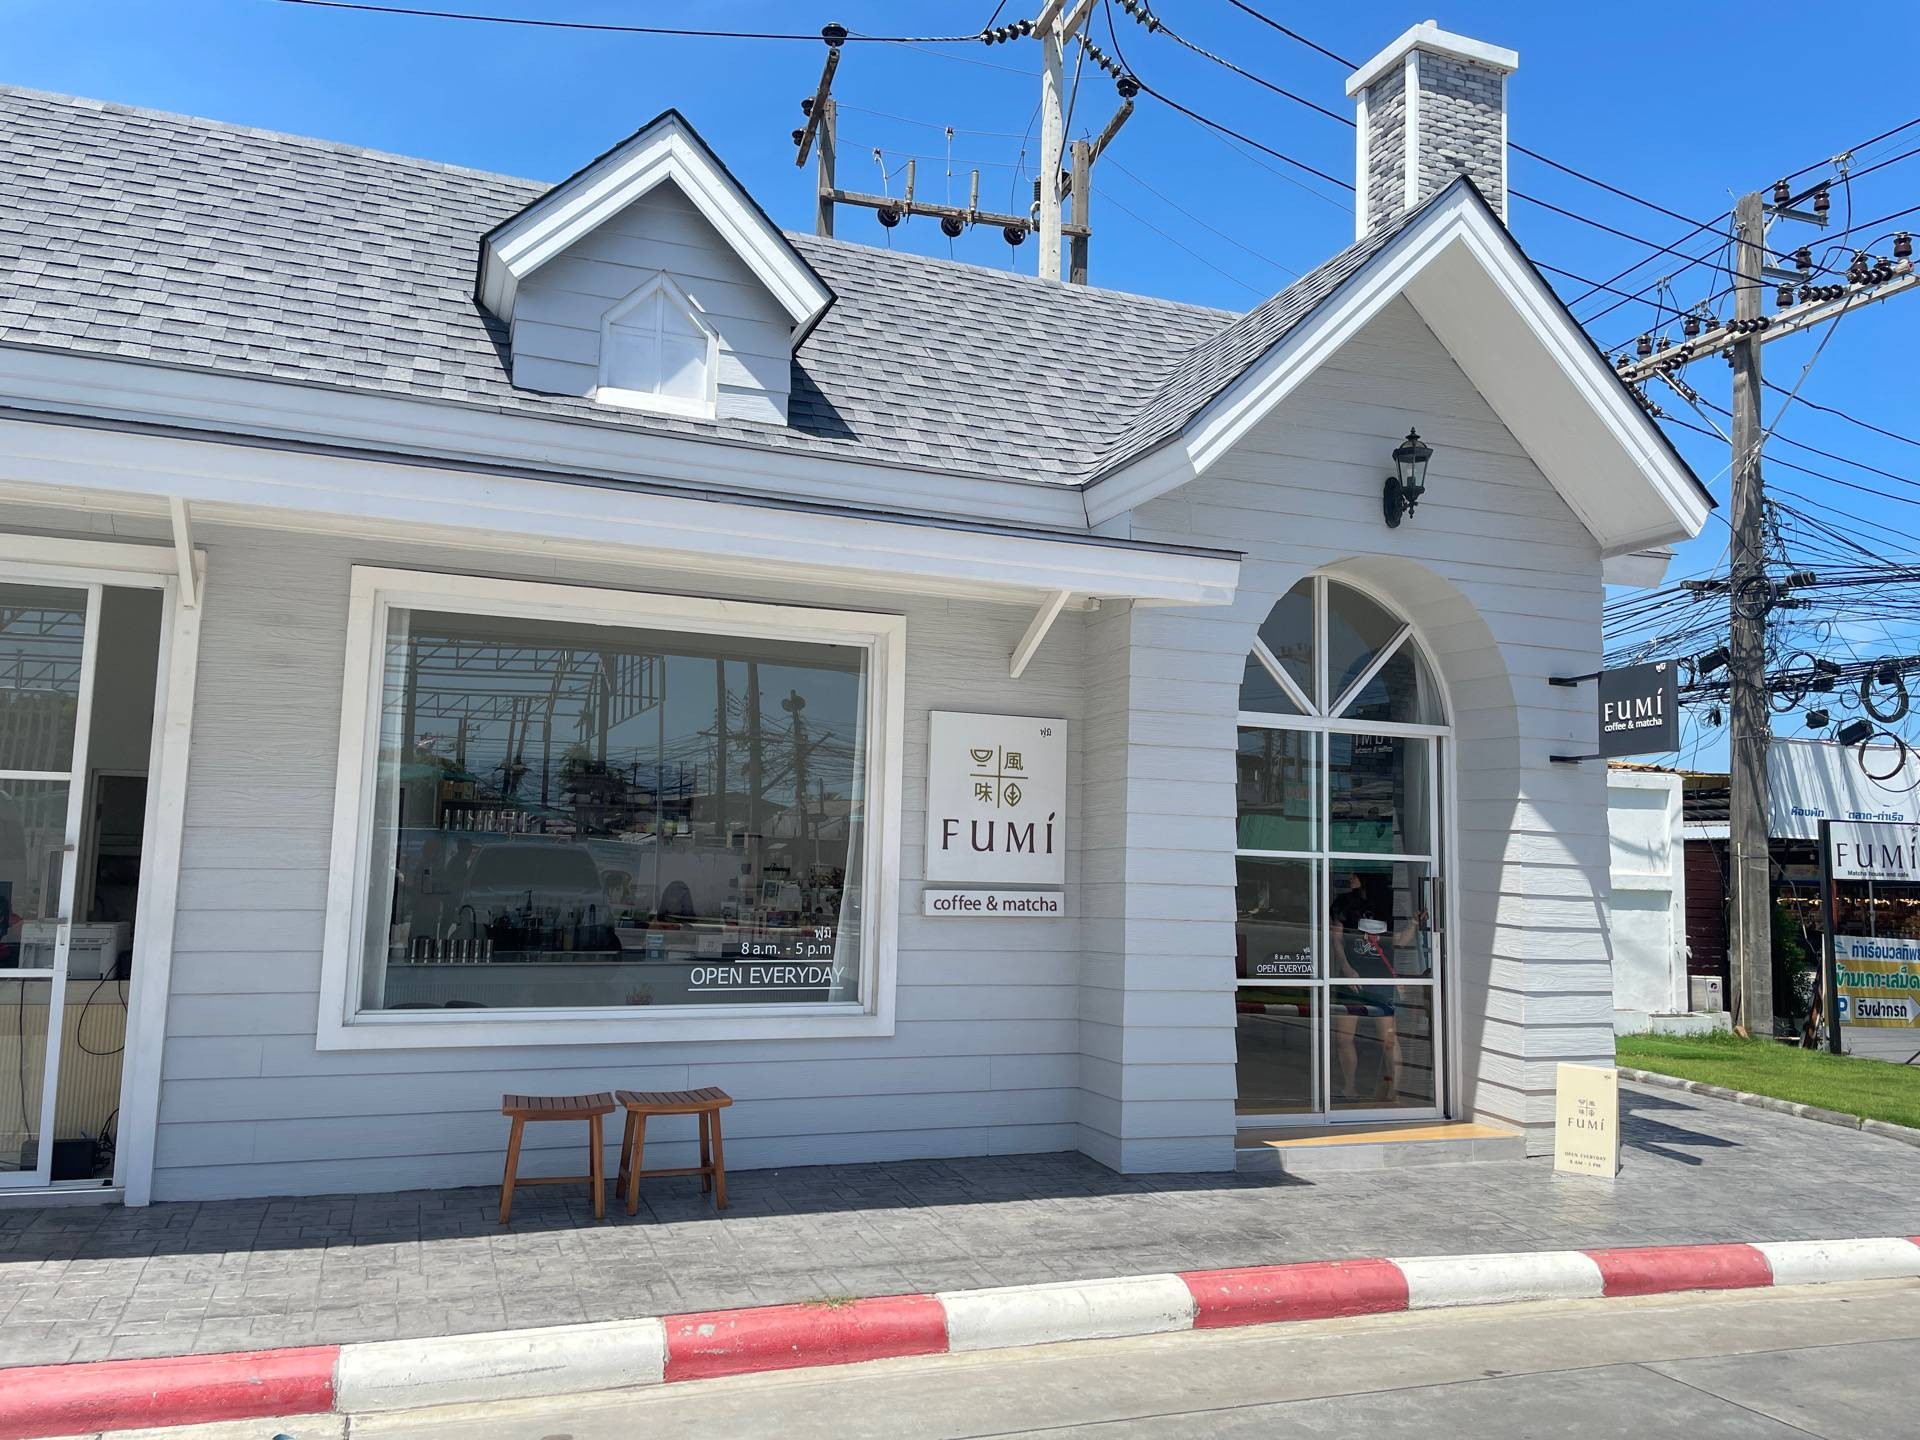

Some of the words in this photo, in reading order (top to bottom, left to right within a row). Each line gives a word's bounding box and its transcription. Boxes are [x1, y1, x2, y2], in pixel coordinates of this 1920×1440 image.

[1604, 722, 1626, 732] coffee
[1628, 720, 1634, 730] &
[1635, 717, 1662, 728] matcha
[1004, 752, 1023, 771] 風
[974, 782, 993, 803] 味
[933, 895, 981, 911] coffee
[986, 895, 998, 911] &
[1003, 896, 1058, 912] matcha
[741, 942, 749, 954] 8
[752, 944, 781, 955] a.m.
[795, 942, 803, 954] 5
[690, 967, 742, 985] OPEN
[750, 966, 845, 984] EVERYDAY
[1256, 964, 1277, 973] OPEN
[1858, 999, 1907, 1017] รับฝากรถ
